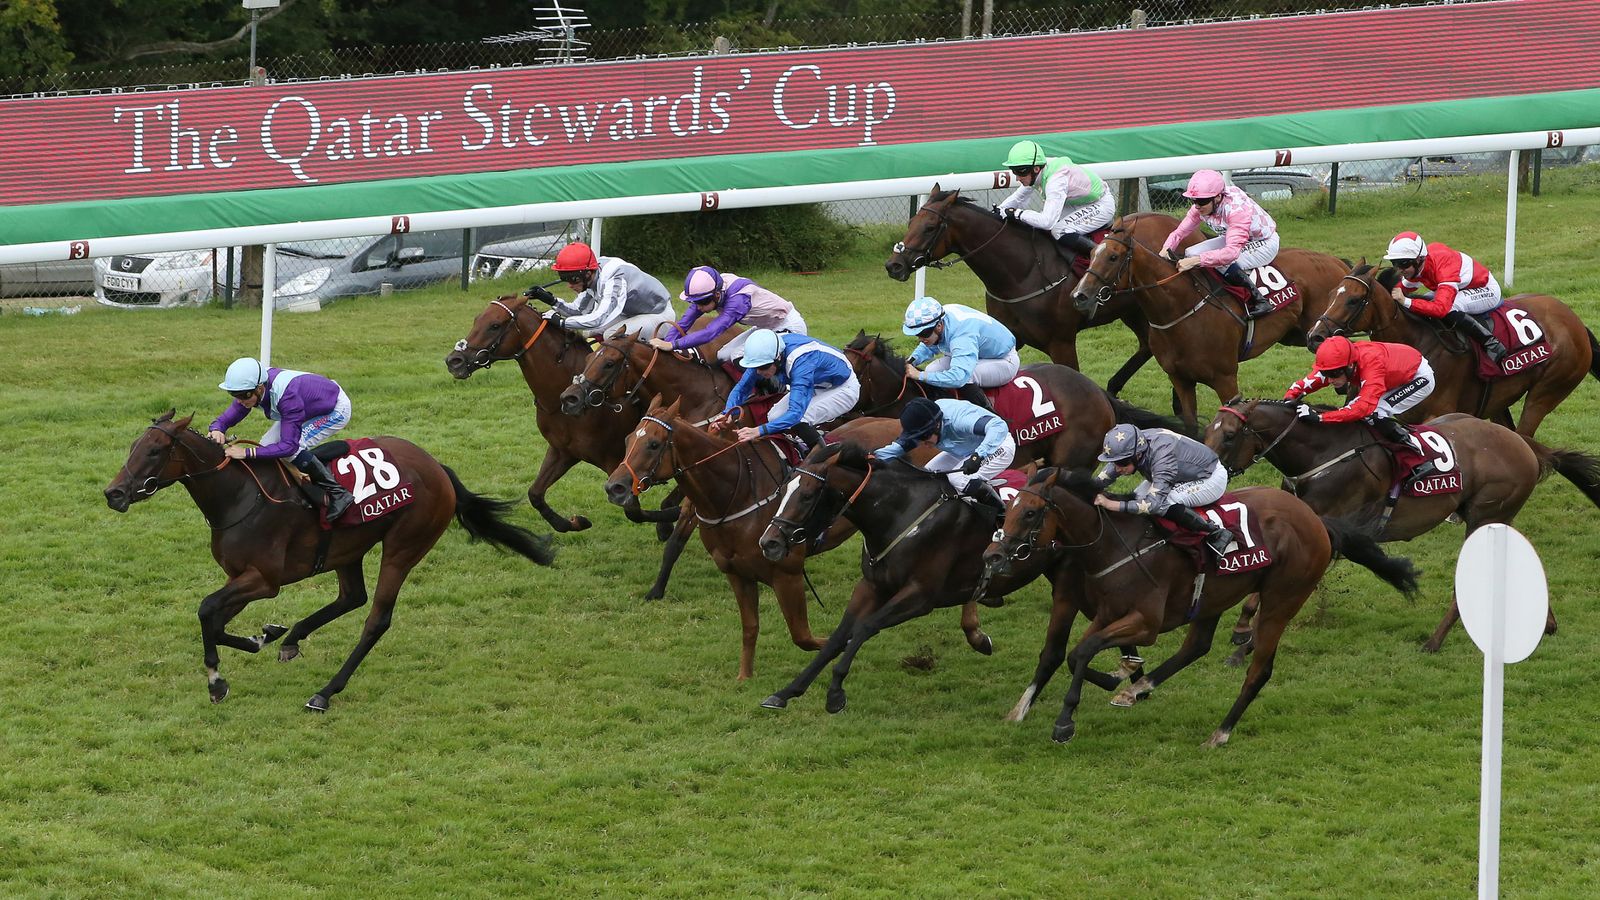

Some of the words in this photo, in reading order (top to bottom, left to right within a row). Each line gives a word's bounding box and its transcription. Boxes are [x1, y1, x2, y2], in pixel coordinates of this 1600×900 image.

[113, 98, 238, 174] The
[260, 96, 443, 183] Qatar
[461, 65, 752, 151] Stewards'
[772, 64, 897, 146] Cup
[1550, 132, 1560, 147] 8
[1279, 151, 1289, 166] 7
[998, 173, 1008, 188] 6
[705, 193, 716, 208] 5
[396, 217, 406, 233] 4
[74, 243, 85, 259] 3
[1268, 286, 1297, 310] ATAR
[1505, 309, 1543, 346] 6
[1505, 345, 1550, 371] QATAR
[1013, 376, 1056, 418] 2
[1389, 384, 1415, 402] RACING
[1415, 378, 1427, 387] UK
[1020, 416, 1063, 440] QATAR
[337, 447, 400, 505] 28
[1414, 476, 1460, 494] QATAR
[363, 488, 412, 516] QATAR
[1219, 550, 1269, 571] QATAR
